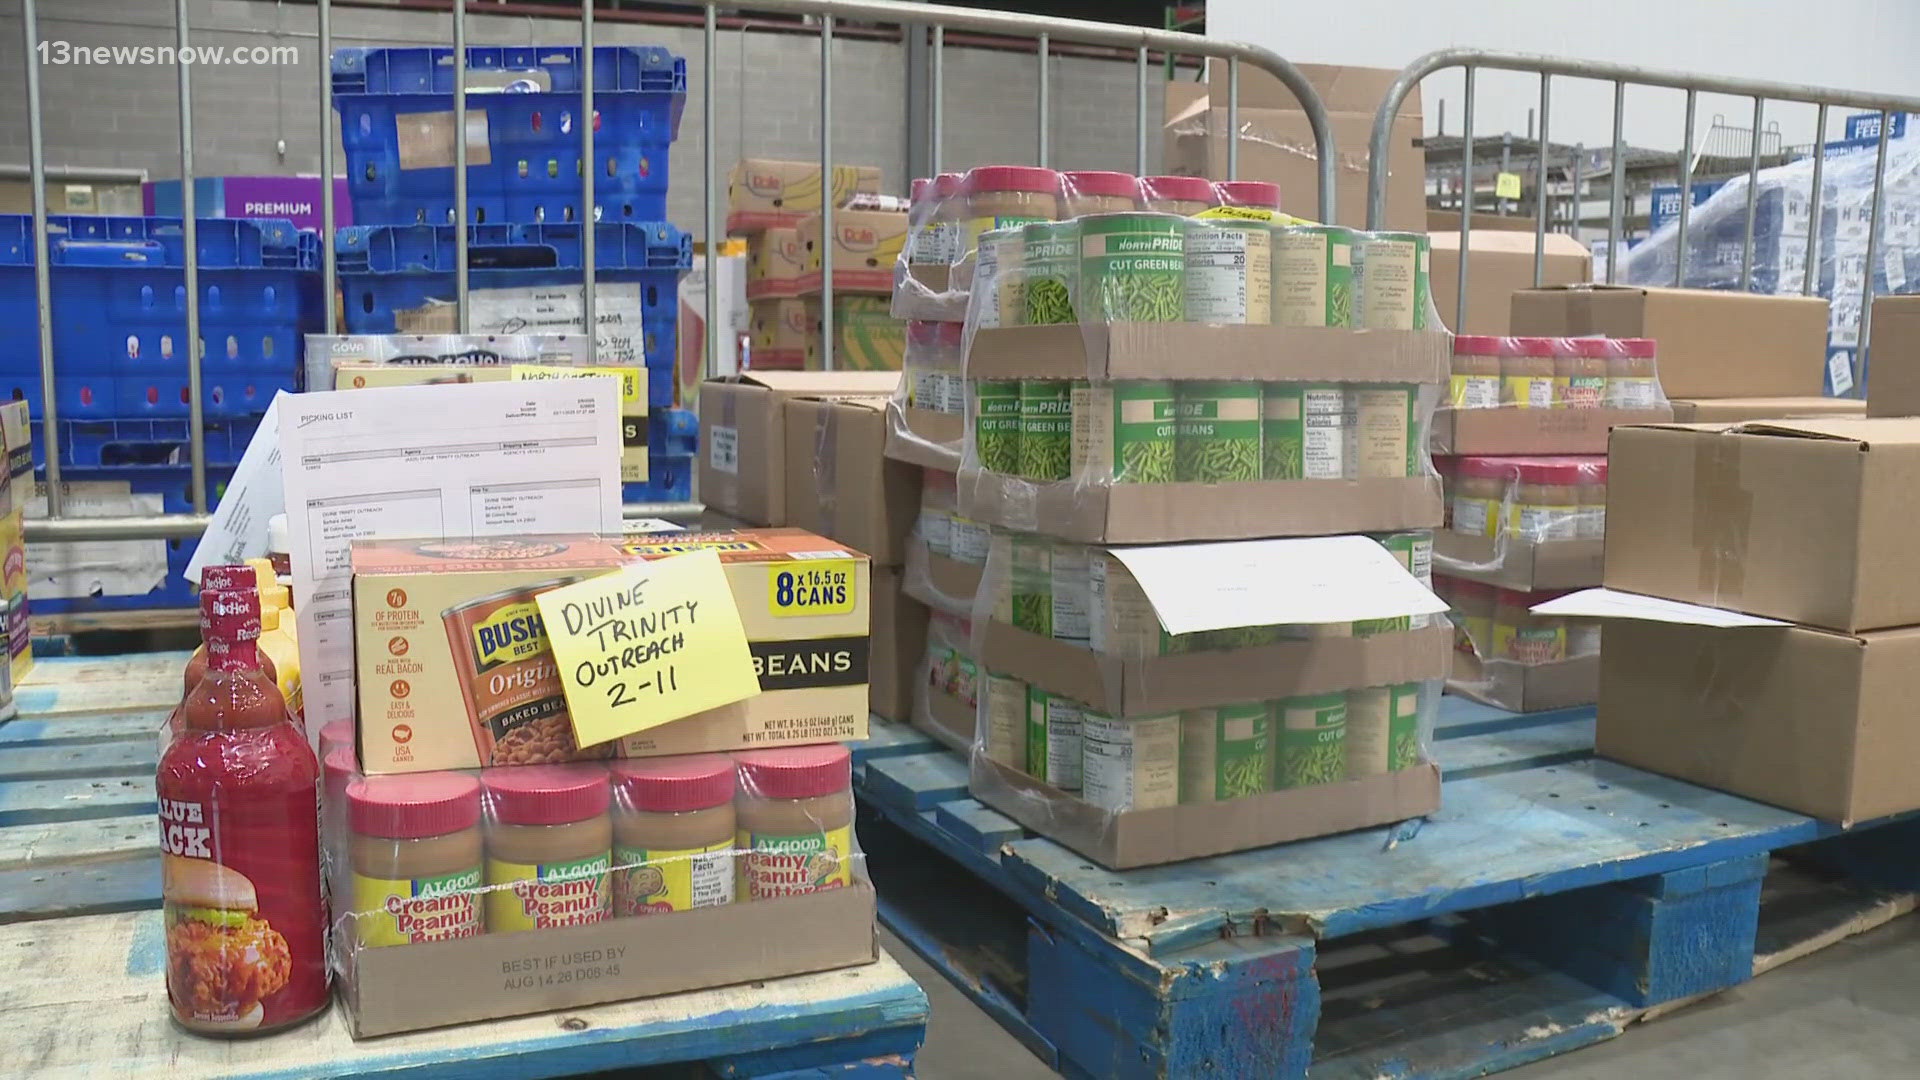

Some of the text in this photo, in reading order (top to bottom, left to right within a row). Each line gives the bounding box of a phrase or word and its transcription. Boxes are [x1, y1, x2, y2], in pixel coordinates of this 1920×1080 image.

[1855, 125, 1895, 139] FEES
[245, 203, 311, 215] PREMIUM
[1109, 261, 1132, 270] CUT
[1134, 259, 1168, 270] GREEN
[1233, 255, 1245, 264] 20
[1039, 401, 1071, 414] PRID
[301, 412, 353, 423] PICKING LIST
[777, 571, 794, 607] 8
[807, 571, 831, 585] 16.5
[834, 571, 846, 584] oz
[796, 587, 846, 605] CANS
[213, 601, 250, 616] RedHot
[375, 610, 419, 621] OF PROTEIN
[561, 579, 649, 635] DIVINE
[478, 613, 548, 657] BUSH
[587, 601, 699, 652] TRINITY
[513, 642, 539, 656] BEST
[576, 632, 685, 687] OUTREACH
[753, 651, 852, 677] BEANS
[376, 663, 423, 675] REAL BACON
[489, 661, 558, 695] Origin
[607, 666, 677, 708] 2-11
[387, 710, 415, 719] DELICIOUS
[391, 701, 405, 710] EASY
[501, 700, 567, 727] BAKED BEA
[764, 720, 775, 730] NET
[838, 715, 854, 724] CANS
[743, 733, 754, 742] NET
[769, 731, 785, 740] TOTAL
[395, 746, 411, 756] USA
[159, 799, 203, 824] LUE
[160, 821, 211, 858] ACK
[757, 839, 821, 854] ALGOOD
[547, 859, 607, 881] ALGOOD
[693, 863, 714, 872] Facts
[744, 852, 807, 871] reamy
[420, 871, 480, 897] ALGOOD
[514, 877, 597, 899] Creamy
[386, 893, 471, 914] Creamy
[523, 892, 599, 916] Peanut
[397, 905, 474, 933] Peanut
[502, 946, 626, 973] BEST IF USED BY
[504, 975, 534, 990] AUG
[538, 973, 553, 987] 14
